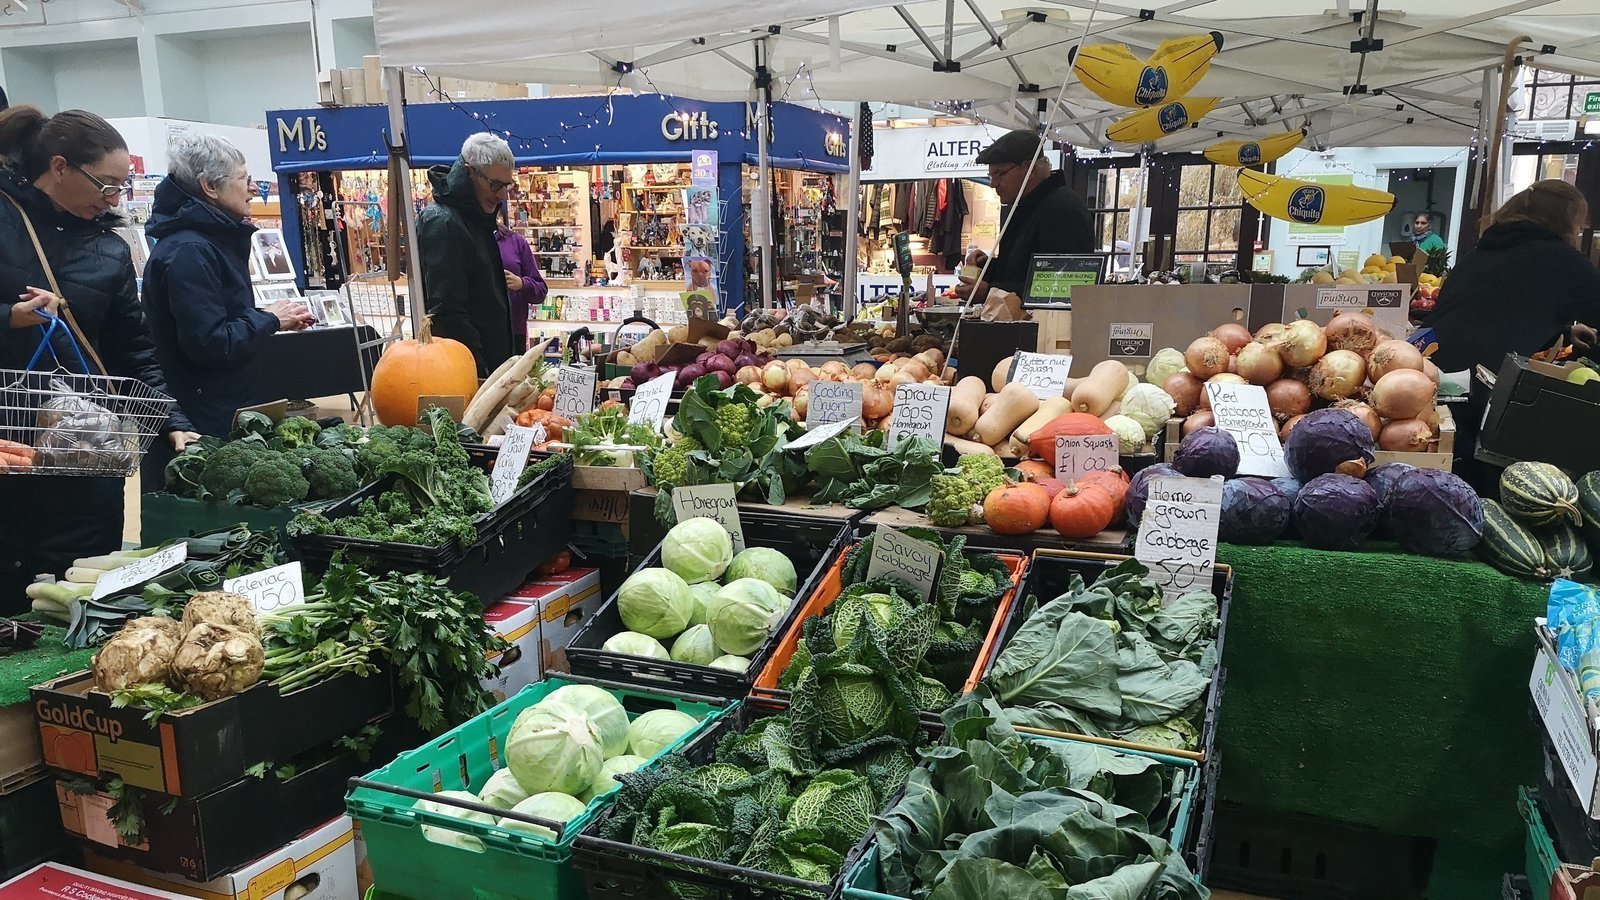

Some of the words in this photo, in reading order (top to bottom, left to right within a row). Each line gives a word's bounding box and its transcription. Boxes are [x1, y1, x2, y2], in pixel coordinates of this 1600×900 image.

[661, 110, 719, 141] Gifts
[926, 160, 959, 171] Clothing
[1288, 205, 1320, 220] Chiquita
[1320, 293, 1359, 305] Original
[1112, 327, 1143, 337] Original
[814, 382, 853, 403] Cooking
[897, 385, 940, 404] Sprout
[1209, 383, 1238, 402] Red
[813, 396, 846, 411] Onion
[1214, 403, 1268, 422] Cabbage
[1056, 437, 1081, 448] Onion
[1083, 437, 1114, 451] Squash
[1153, 480, 1193, 505] Home
[1154, 505, 1208, 529] grown
[878, 532, 932, 574] Savoy
[1145, 529, 1210, 558] Cabbage
[875, 549, 933, 582] Cabbage
[232, 571, 287, 595] Celeriac
[36, 699, 123, 741] GoldCup
